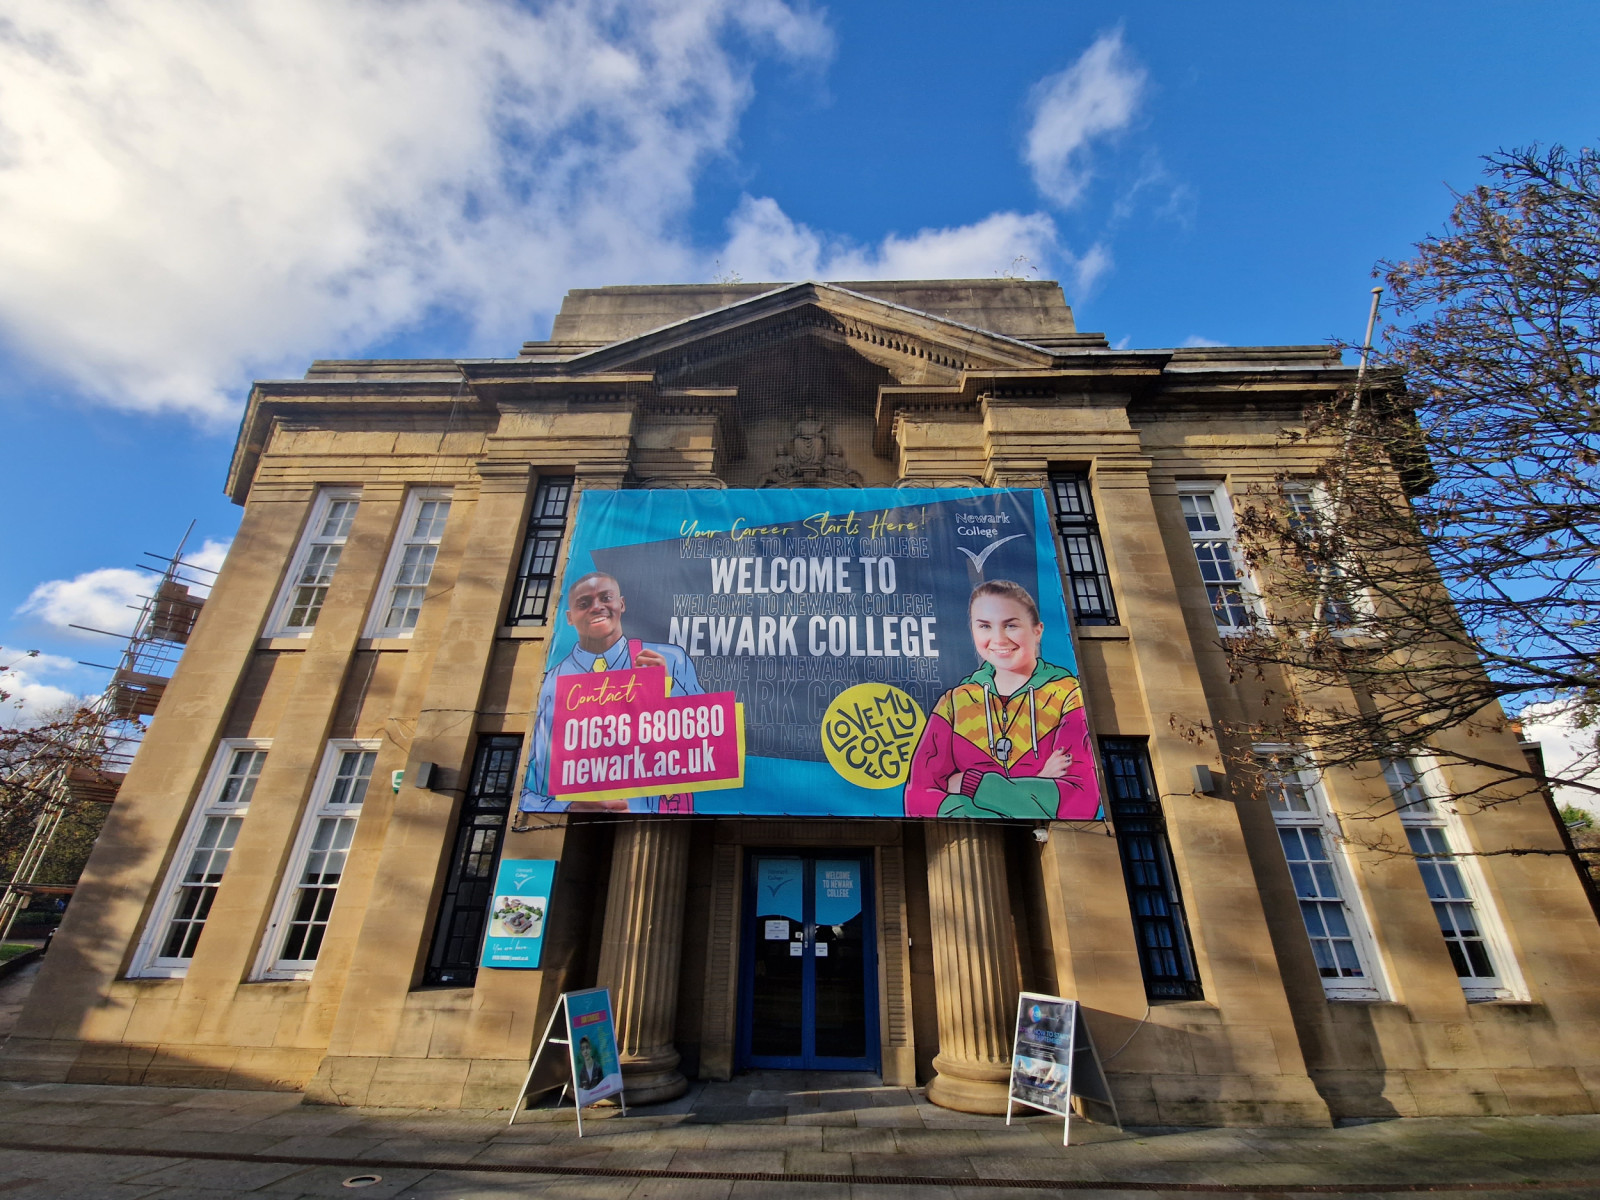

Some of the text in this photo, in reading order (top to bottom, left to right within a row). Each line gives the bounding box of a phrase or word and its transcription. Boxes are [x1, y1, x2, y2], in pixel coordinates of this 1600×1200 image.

[679, 506, 926, 547] Your Career Starts Here!
[955, 511, 1010, 524] Newark
[957, 526, 998, 537] College
[679, 537, 930, 559] WELCOME TO NEWARK COLLEGE
[711, 557, 897, 594] WELCOME TO
[673, 594, 935, 617] WELCOME TO NEWARK COLLEGE
[668, 616, 939, 657] NEWARK COLLEGE
[755, 656, 776, 680] TO
[782, 656, 859, 680] NEWARK
[863, 656, 940, 681] COLLEGE
[566, 674, 642, 711] Contact
[564, 704, 725, 751] 01636 680680
[825, 702, 883, 752] LOVE
[873, 687, 917, 730] MY
[561, 739, 716, 786] newark.ac.uk
[823, 880, 853, 888] TO NEWARK
[825, 871, 851, 880] WELCOME
[827, 889, 849, 898] COLLEGE
